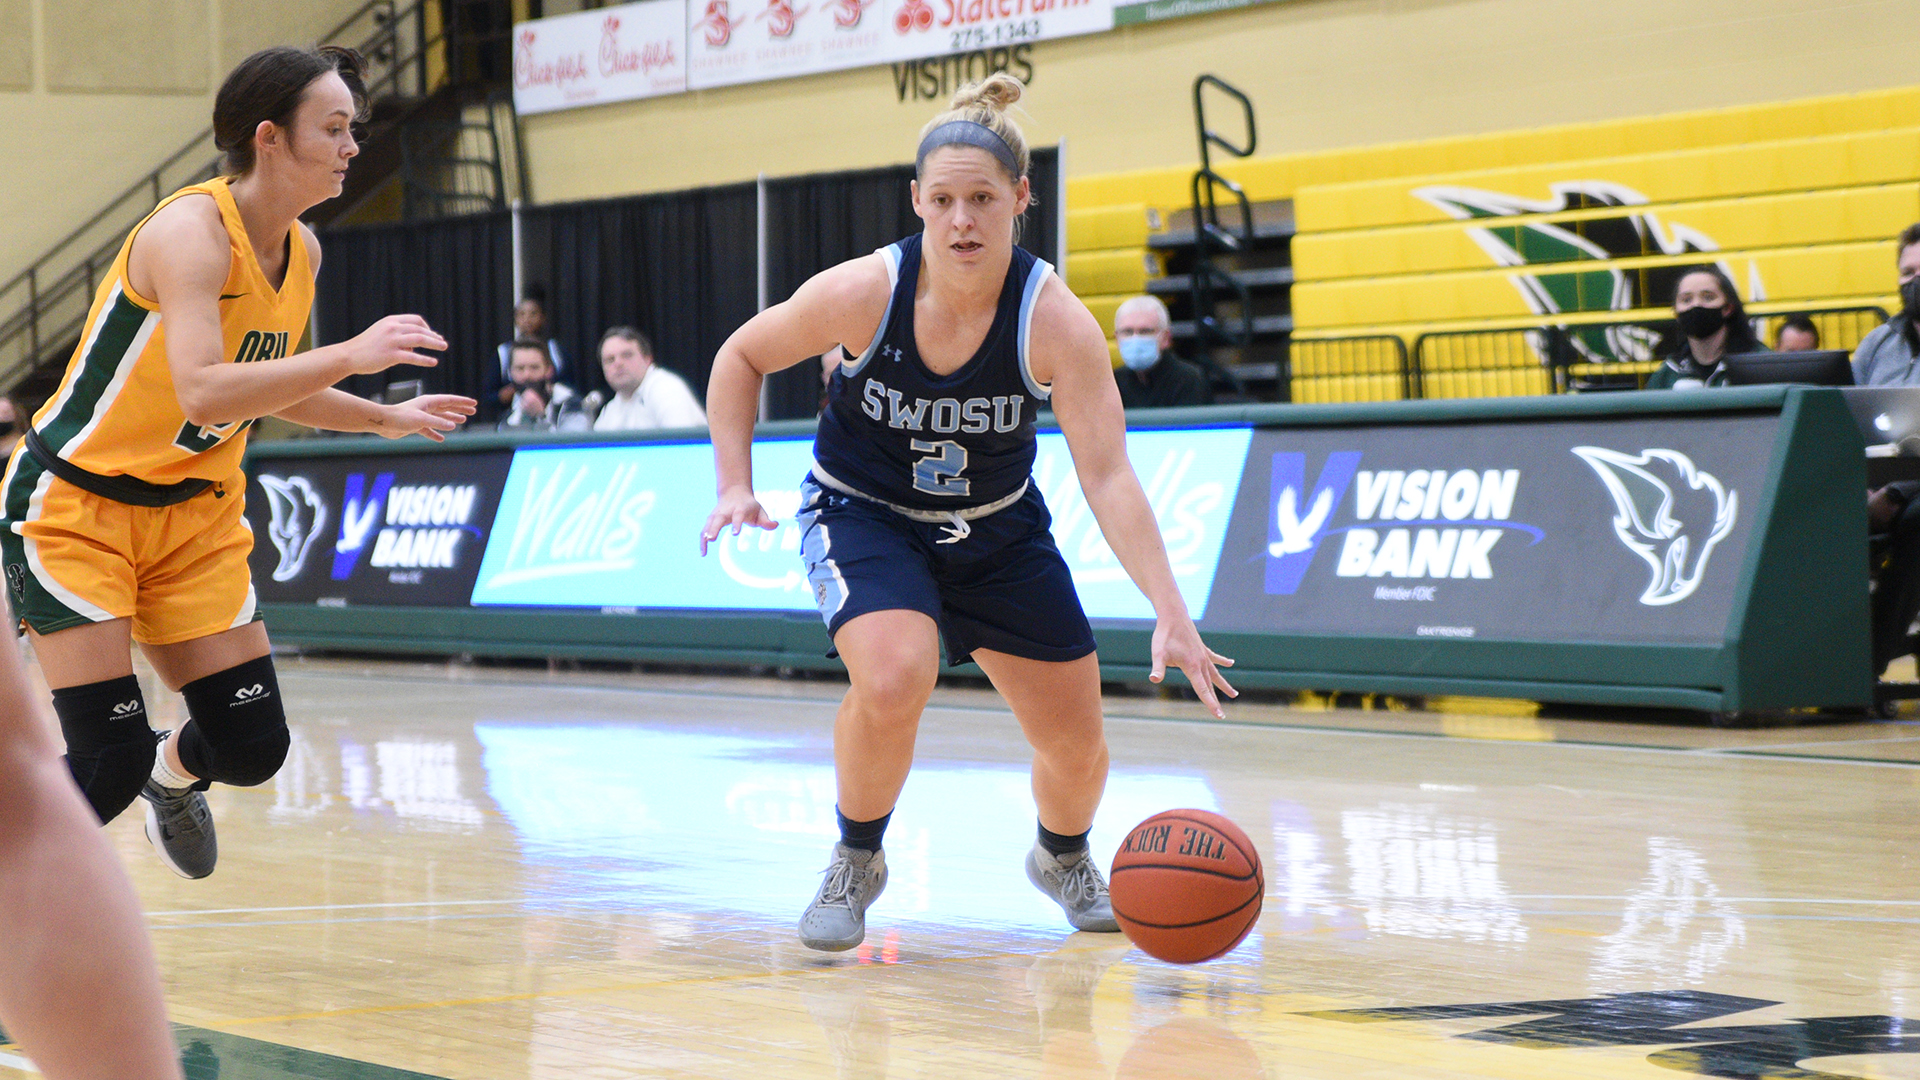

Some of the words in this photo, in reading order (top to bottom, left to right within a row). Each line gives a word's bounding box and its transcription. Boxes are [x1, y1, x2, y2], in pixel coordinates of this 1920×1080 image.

[950, 18, 1041, 50] 275-1343
[861, 377, 1024, 434] SWOSU
[909, 437, 970, 496] 2
[385, 484, 477, 526] VISION
[502, 460, 657, 572] Walls
[1356, 469, 1520, 521] VISION
[369, 528, 462, 568] BANK
[1336, 528, 1504, 580] BANK
[1373, 585, 1412, 600] Member
[1412, 585, 1437, 601] FDIC
[1123, 825, 1173, 853] ROCK
[1179, 827, 1227, 861] THE
